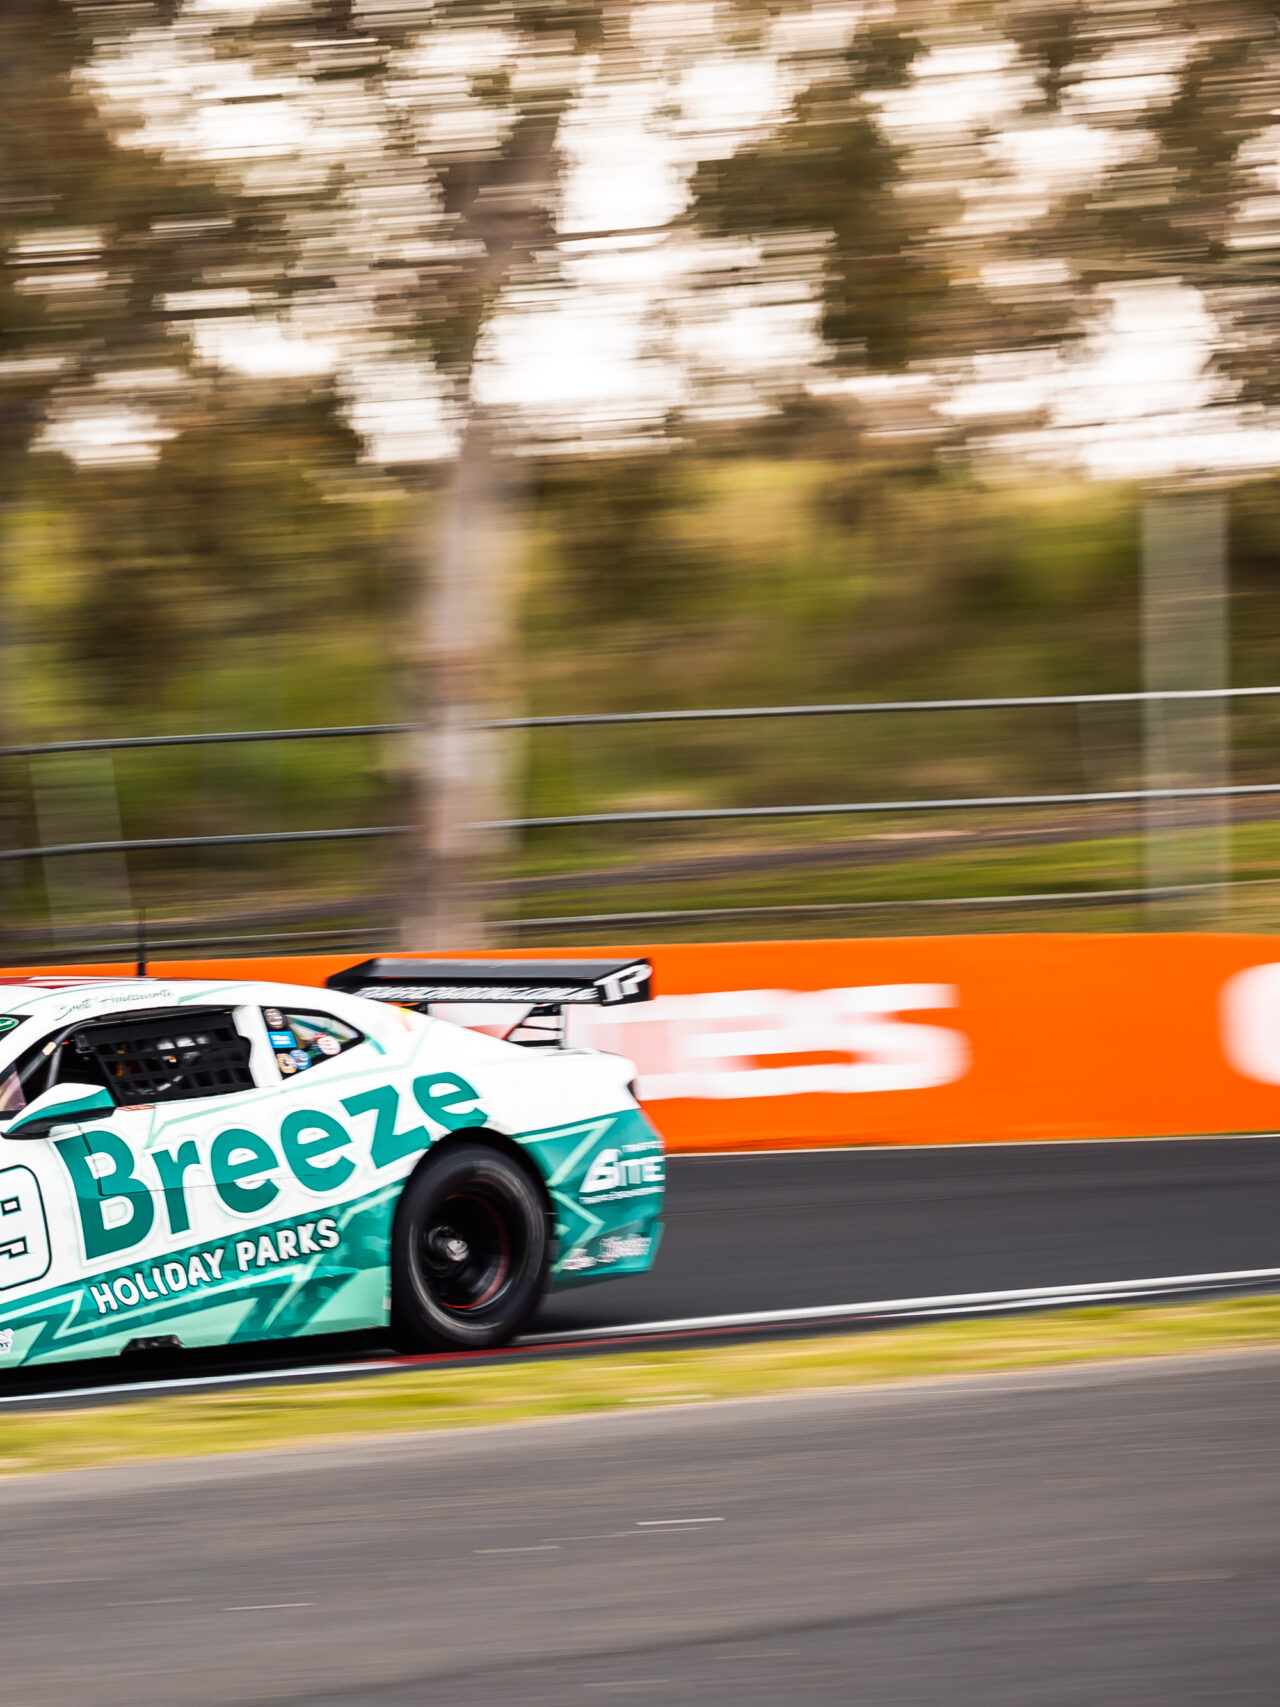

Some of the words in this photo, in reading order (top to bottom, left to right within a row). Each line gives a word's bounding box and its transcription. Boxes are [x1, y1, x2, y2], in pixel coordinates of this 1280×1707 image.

[54, 1071, 489, 1260] Breeze
[89, 1247, 224, 1315] HOLIDAY
[237, 1217, 341, 1271] PARKS
